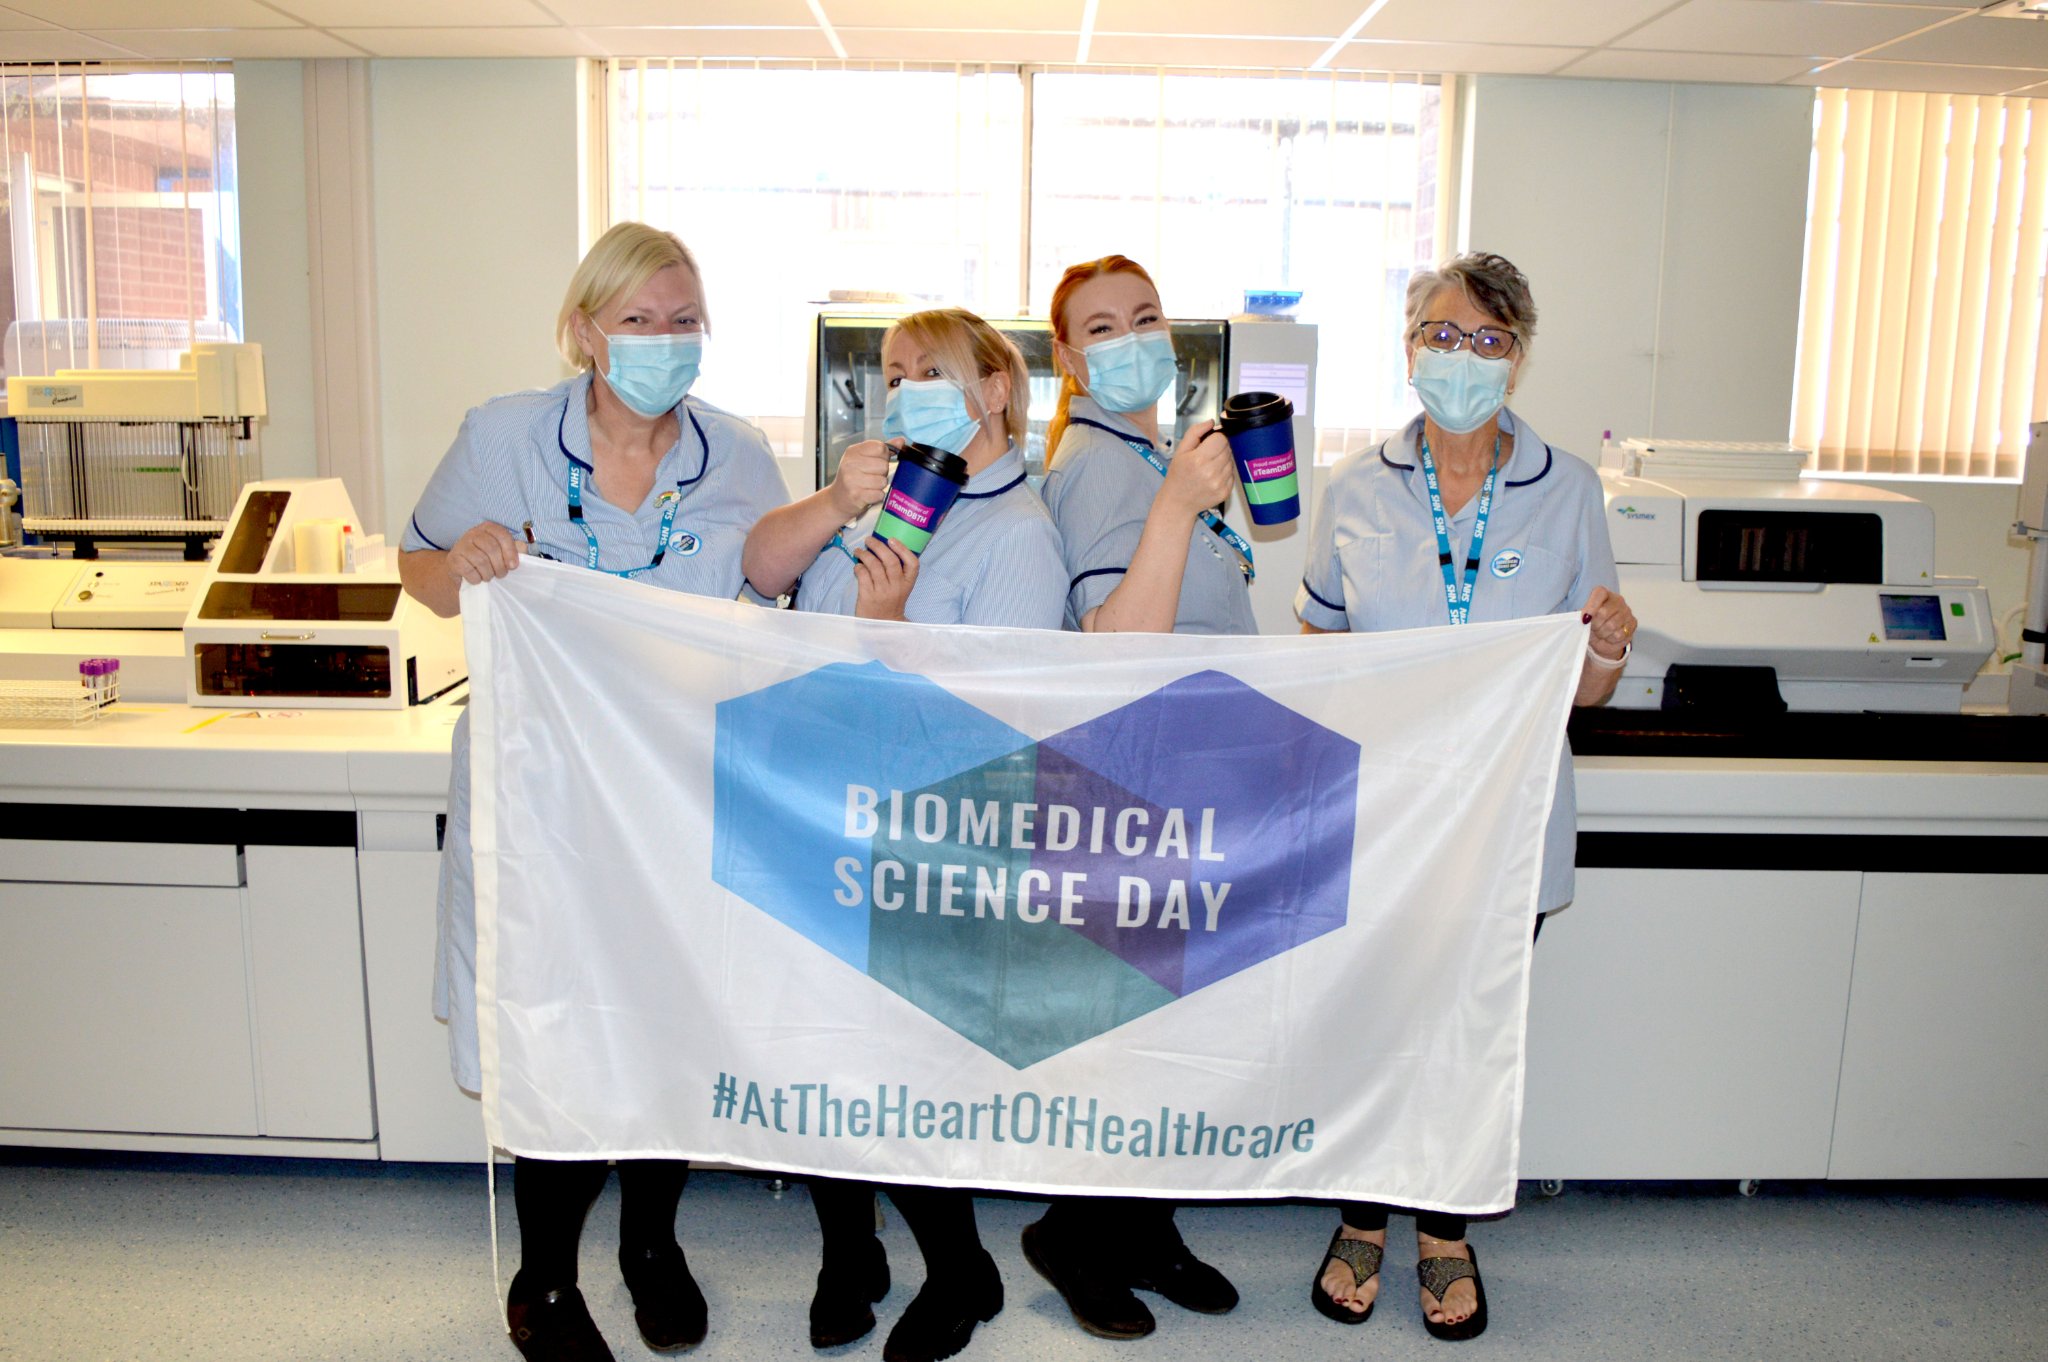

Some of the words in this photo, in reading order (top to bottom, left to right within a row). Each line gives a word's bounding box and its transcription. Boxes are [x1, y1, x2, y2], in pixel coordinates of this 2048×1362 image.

[1147, 454, 1164, 471] NHS
[570, 466, 580, 489] NHS
[1427, 472, 1438, 490] NHS
[1484, 474, 1494, 492] NHS
[1431, 494, 1442, 512] NHS
[1479, 496, 1490, 516] NHS
[1434, 516, 1447, 535] NHS
[1474, 519, 1486, 539] NHS
[660, 526, 670, 546] NHS
[588, 545, 598, 568] NHS
[1446, 584, 1458, 603] NHS
[1461, 582, 1473, 603] NHS
[844, 783, 1226, 862] BIOMEDICAL
[833, 856, 1088, 926] SCIENCE
[1116, 876, 1232, 932] DAY
[712, 1072, 1316, 1159] #AtTheHeartOfHealthcare
